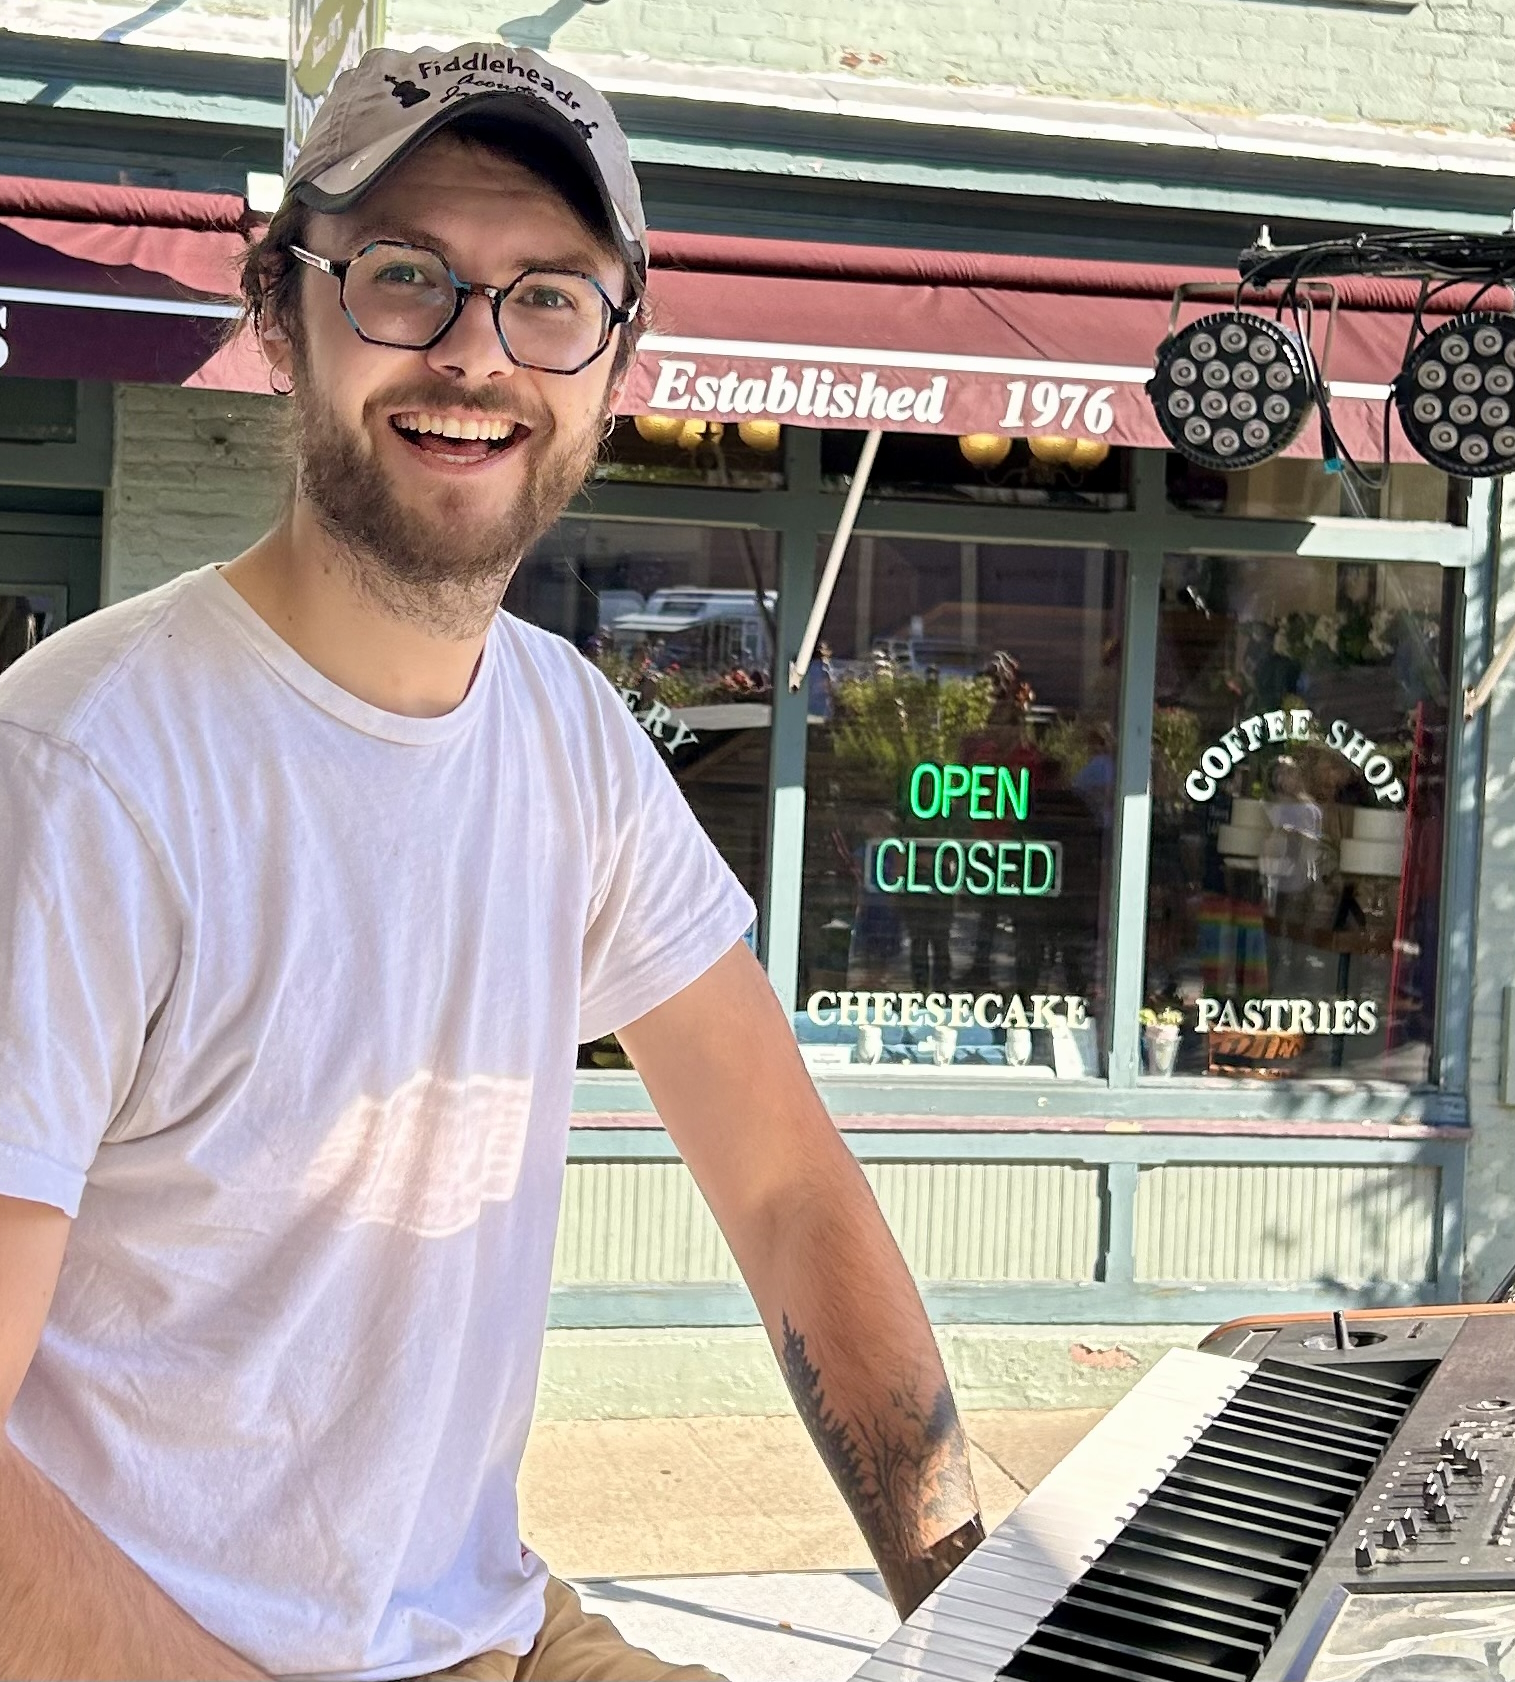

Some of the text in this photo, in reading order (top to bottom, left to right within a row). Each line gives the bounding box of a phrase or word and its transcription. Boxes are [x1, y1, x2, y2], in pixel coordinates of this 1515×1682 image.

[418, 52, 581, 110] Fiddleheads
[646, 359, 1116, 434] Established 1976
[1185, 709, 1405, 804] COFFEE SHOP
[911, 762, 1030, 820] OPEN
[876, 838, 1055, 896] CLOSED
[806, 990, 1089, 1030] CHEESECAKE
[1194, 998, 1378, 1035] PASTRIES
